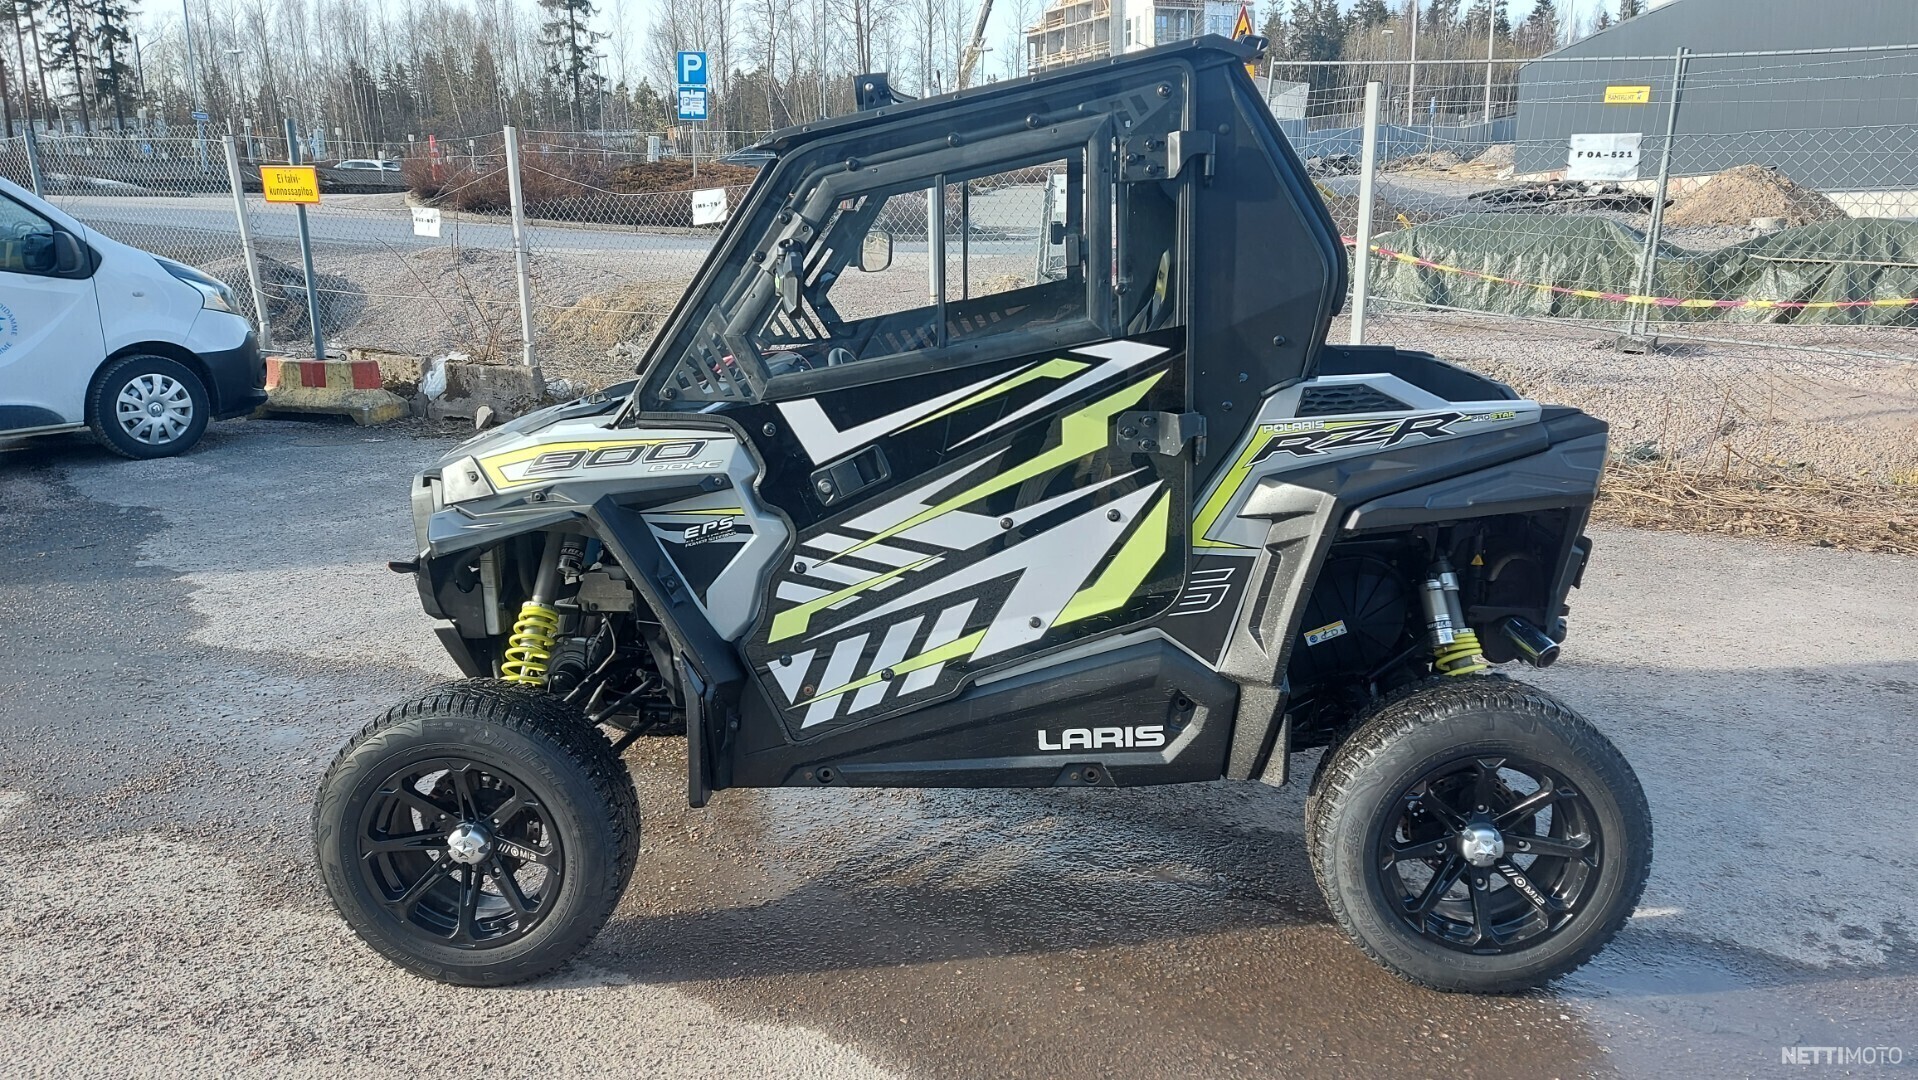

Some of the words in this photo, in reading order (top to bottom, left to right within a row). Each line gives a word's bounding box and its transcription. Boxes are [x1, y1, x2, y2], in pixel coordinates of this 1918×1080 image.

[683, 54, 703, 82] P
[276, 173, 284, 184] Ei
[284, 173, 301, 184] talvi-
[268, 185, 314, 198] kunnossapitoa
[1263, 420, 1325, 433] POLARIS
[1241, 411, 1466, 468] RZR
[524, 440, 709, 476] 900
[648, 460, 723, 472] DOHC
[684, 515, 735, 539] EPS
[1037, 725, 1166, 751] LARIS
